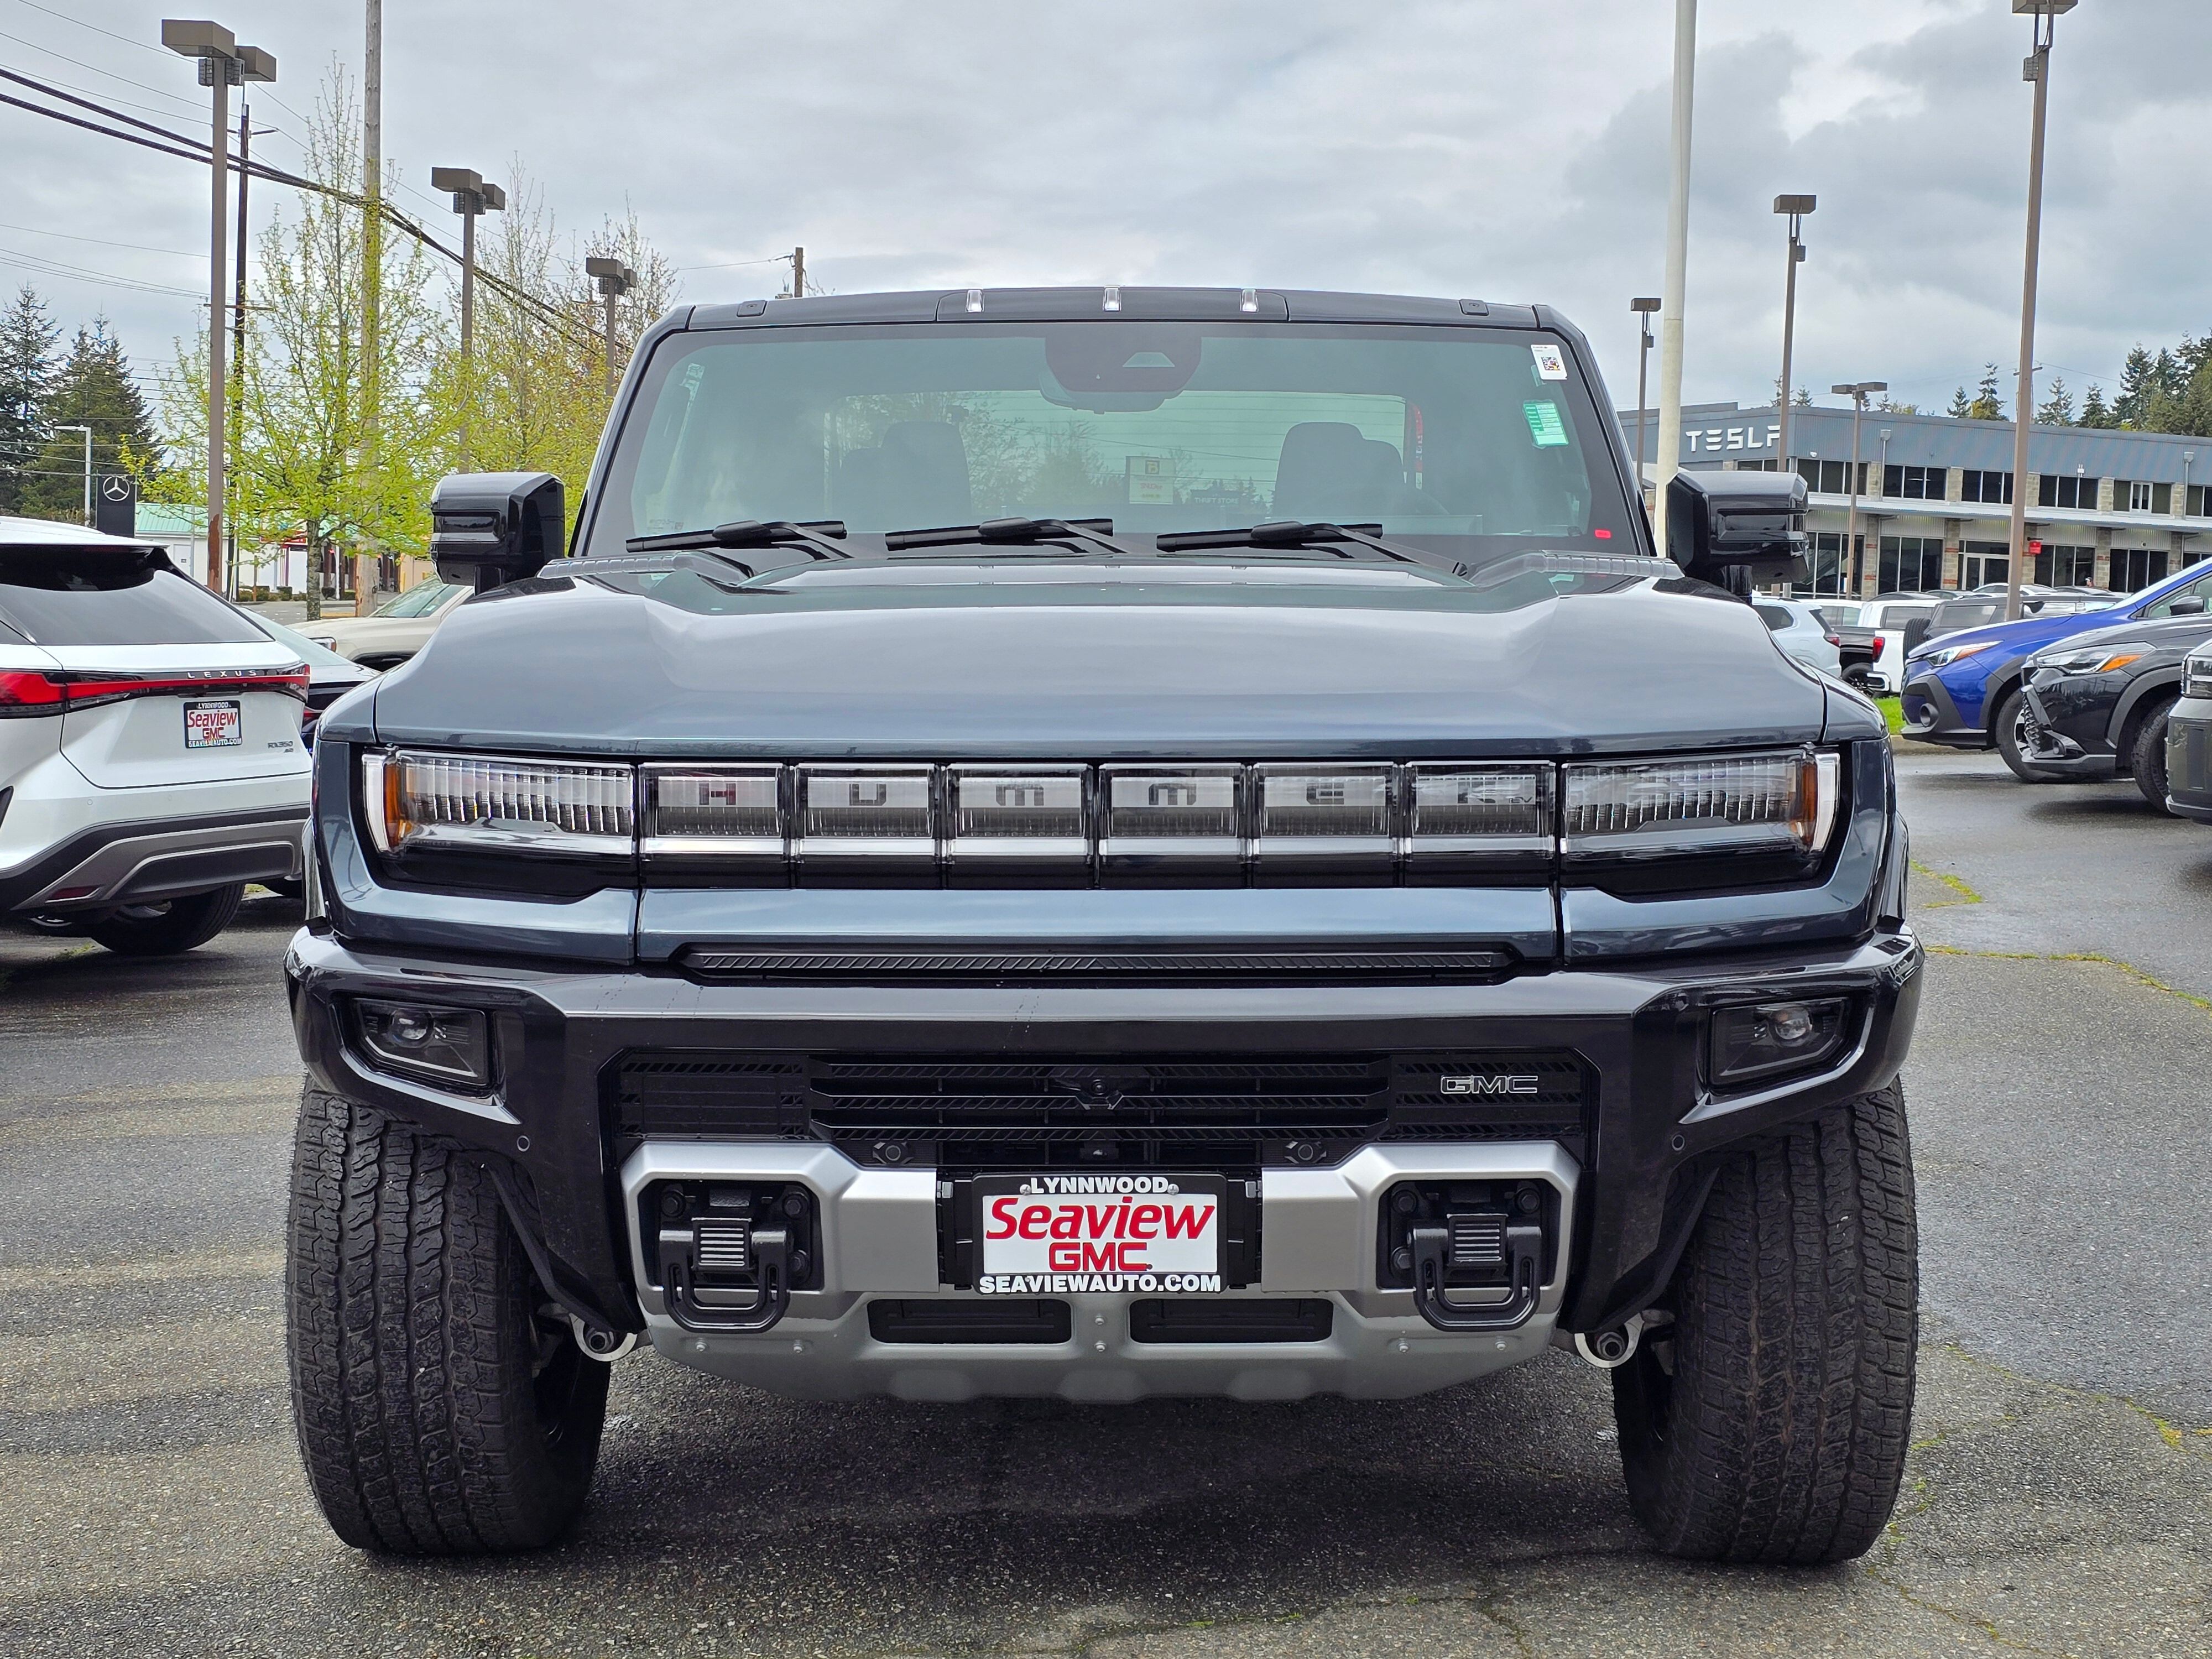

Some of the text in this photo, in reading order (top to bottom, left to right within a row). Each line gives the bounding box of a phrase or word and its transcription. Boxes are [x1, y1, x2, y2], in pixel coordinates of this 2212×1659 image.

[187, 670, 257, 679] LEXUS
[187, 710, 237, 728] Seaview
[202, 727, 225, 739] GMC
[1441, 1076, 1538, 1094] GMC
[1031, 1177, 1168, 1194] LYNNWOOD
[986, 1196, 1215, 1239] Seaview
[1049, 1242, 1148, 1271] GMC
[979, 1274, 1220, 1293] SEAVIEWAUTO.COM
